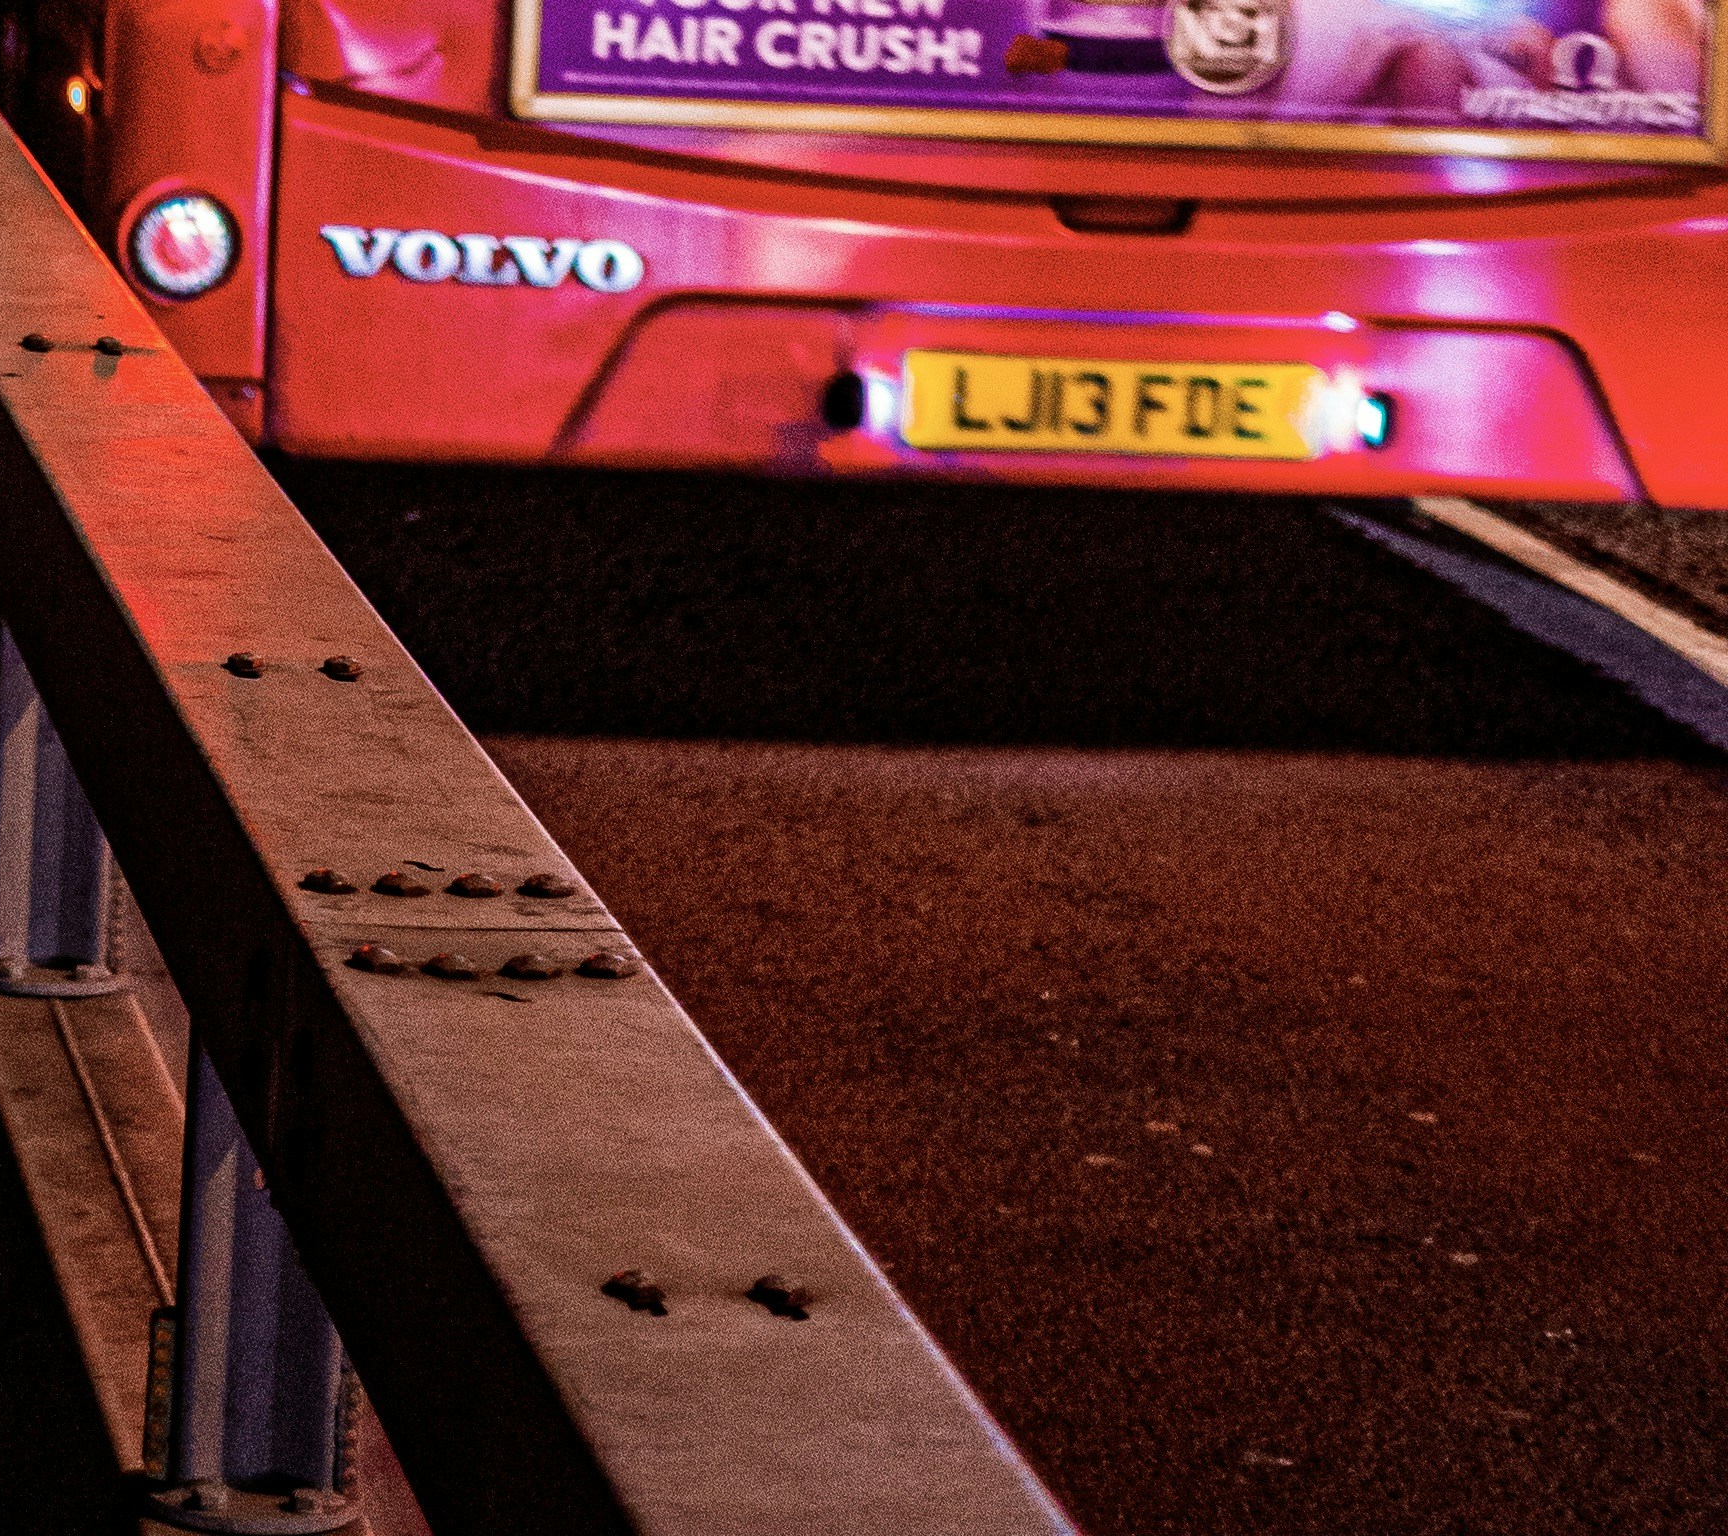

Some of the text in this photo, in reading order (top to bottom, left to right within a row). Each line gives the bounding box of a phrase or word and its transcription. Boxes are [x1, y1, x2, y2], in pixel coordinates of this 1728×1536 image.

[590, 11, 744, 68] HAIR
[319, 224, 645, 294] VOLVO
[950, 366, 1270, 442] LJ13 FDE
